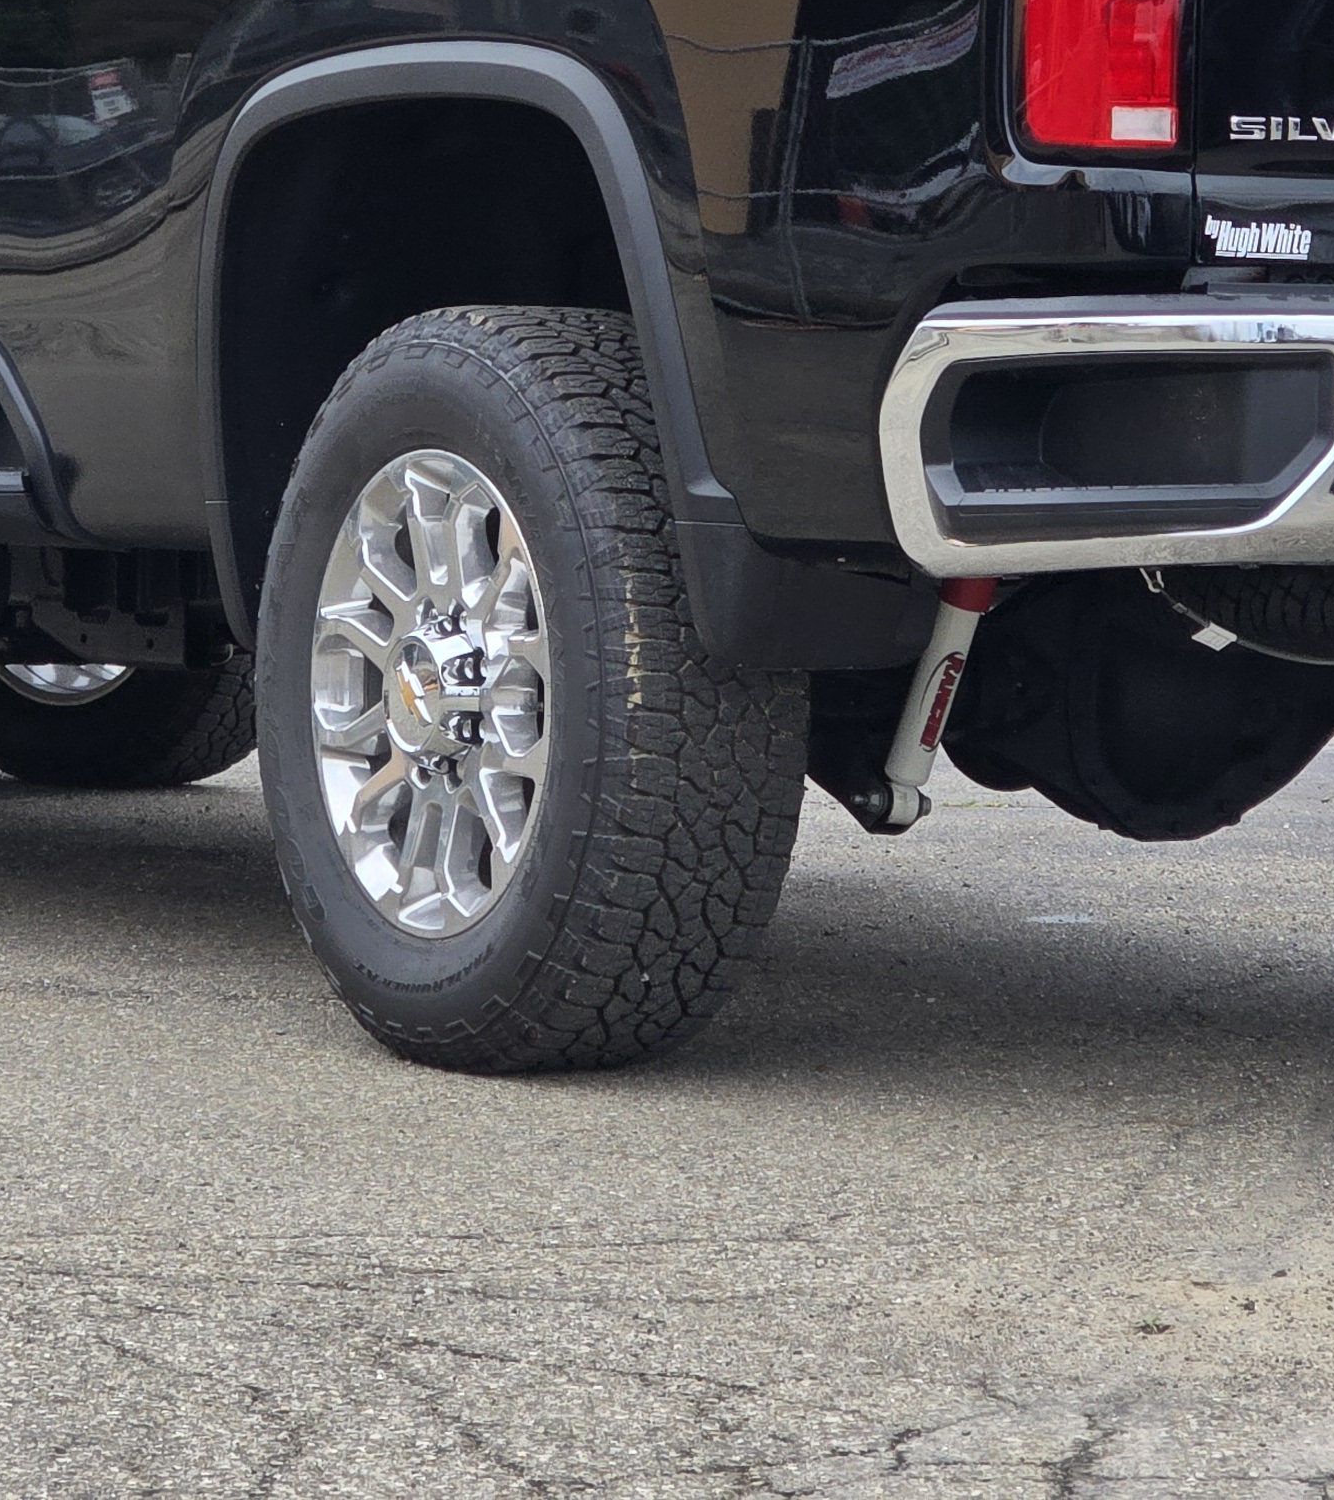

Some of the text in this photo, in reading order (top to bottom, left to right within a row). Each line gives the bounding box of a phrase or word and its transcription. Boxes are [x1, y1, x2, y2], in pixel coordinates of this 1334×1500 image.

[1204, 214, 1313, 258] by Hugh White
